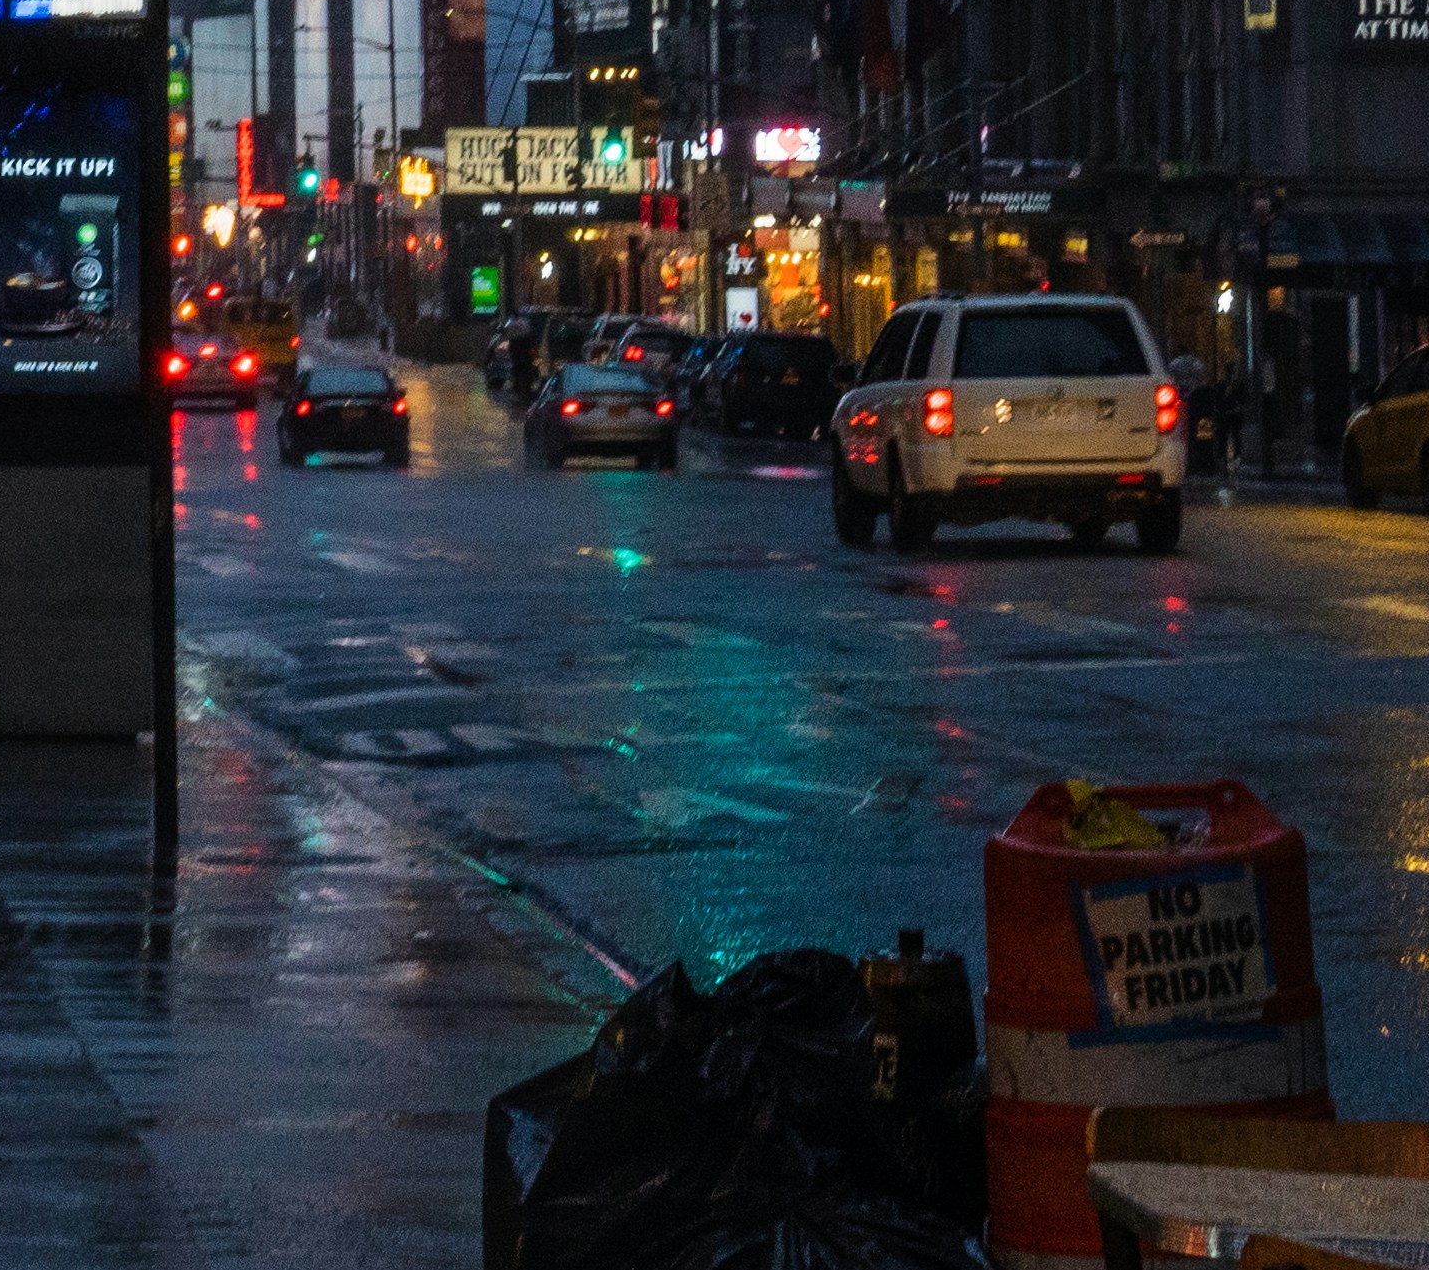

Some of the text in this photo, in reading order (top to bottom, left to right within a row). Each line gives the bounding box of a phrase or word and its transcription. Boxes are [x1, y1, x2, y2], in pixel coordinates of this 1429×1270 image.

[1384, 17, 1429, 40] TIM
[0, 158, 117, 177] KICK IT UP!
[1148, 882, 1202, 921] NO
[1102, 914, 1256, 970] PARKING
[1124, 960, 1245, 1011] FRIDAY
